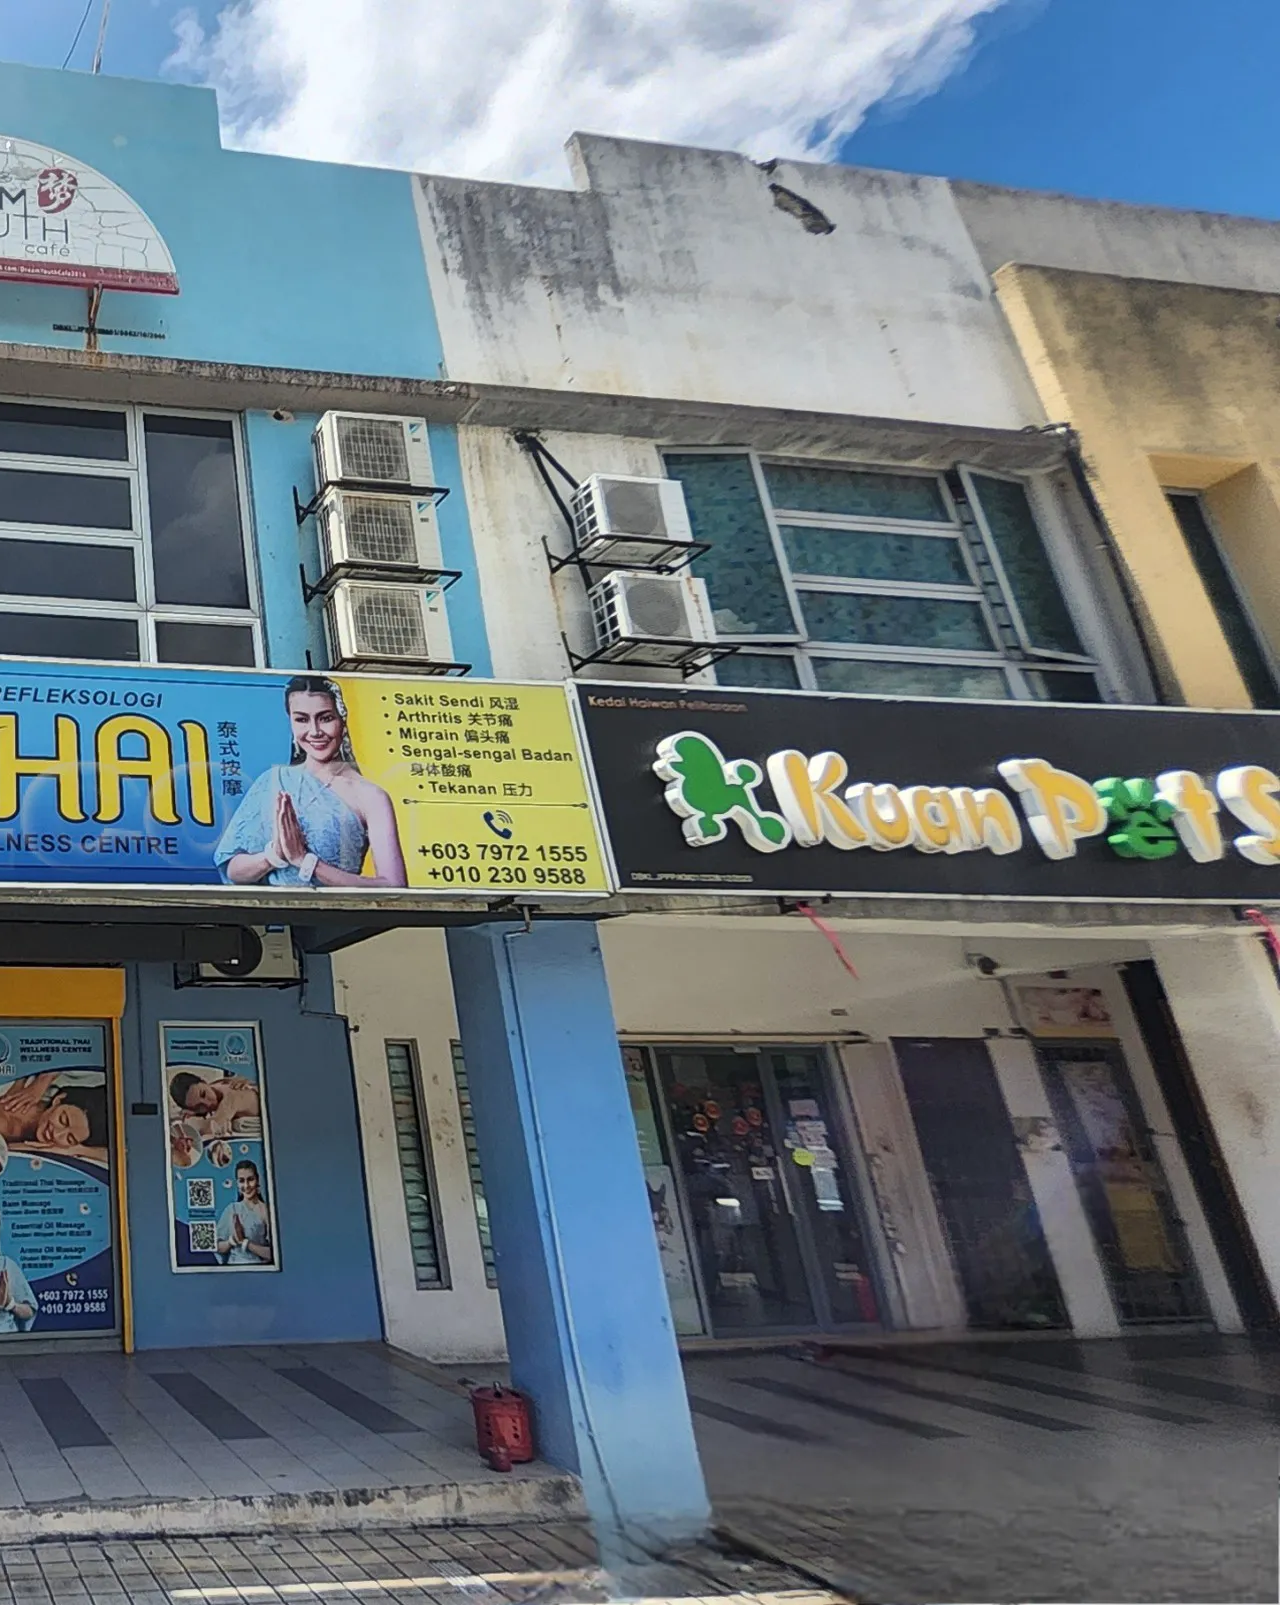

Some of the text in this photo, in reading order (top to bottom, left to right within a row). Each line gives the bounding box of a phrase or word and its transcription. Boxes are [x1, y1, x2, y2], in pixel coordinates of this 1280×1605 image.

[394, 693, 520, 711] Sakit Sendi 风湿
[587, 695, 627, 708] Kedai
[628, 697, 678, 710] Haiwan
[397, 710, 463, 725] Arthritis
[399, 728, 459, 743] Migrain
[217, 720, 244, 797] 泰式按摩
[401, 745, 574, 762] Sengal-sengal Badan
[429, 780, 534, 797] Tekanan 压力
[767, 749, 1023, 855] Kuan
[80, 834, 179, 855] CENTRE
[418, 843, 589, 862] +603 7972 1555
[428, 865, 587, 885] +010 230 9588
[19, 1038, 91, 1046] TRADITIONAL THAI
[38, 1290, 61, 1301] +603
[87, 1288, 109, 1300] 1555
[41, 1303, 64, 1315] +010
[65, 1302, 83, 1314] 230
